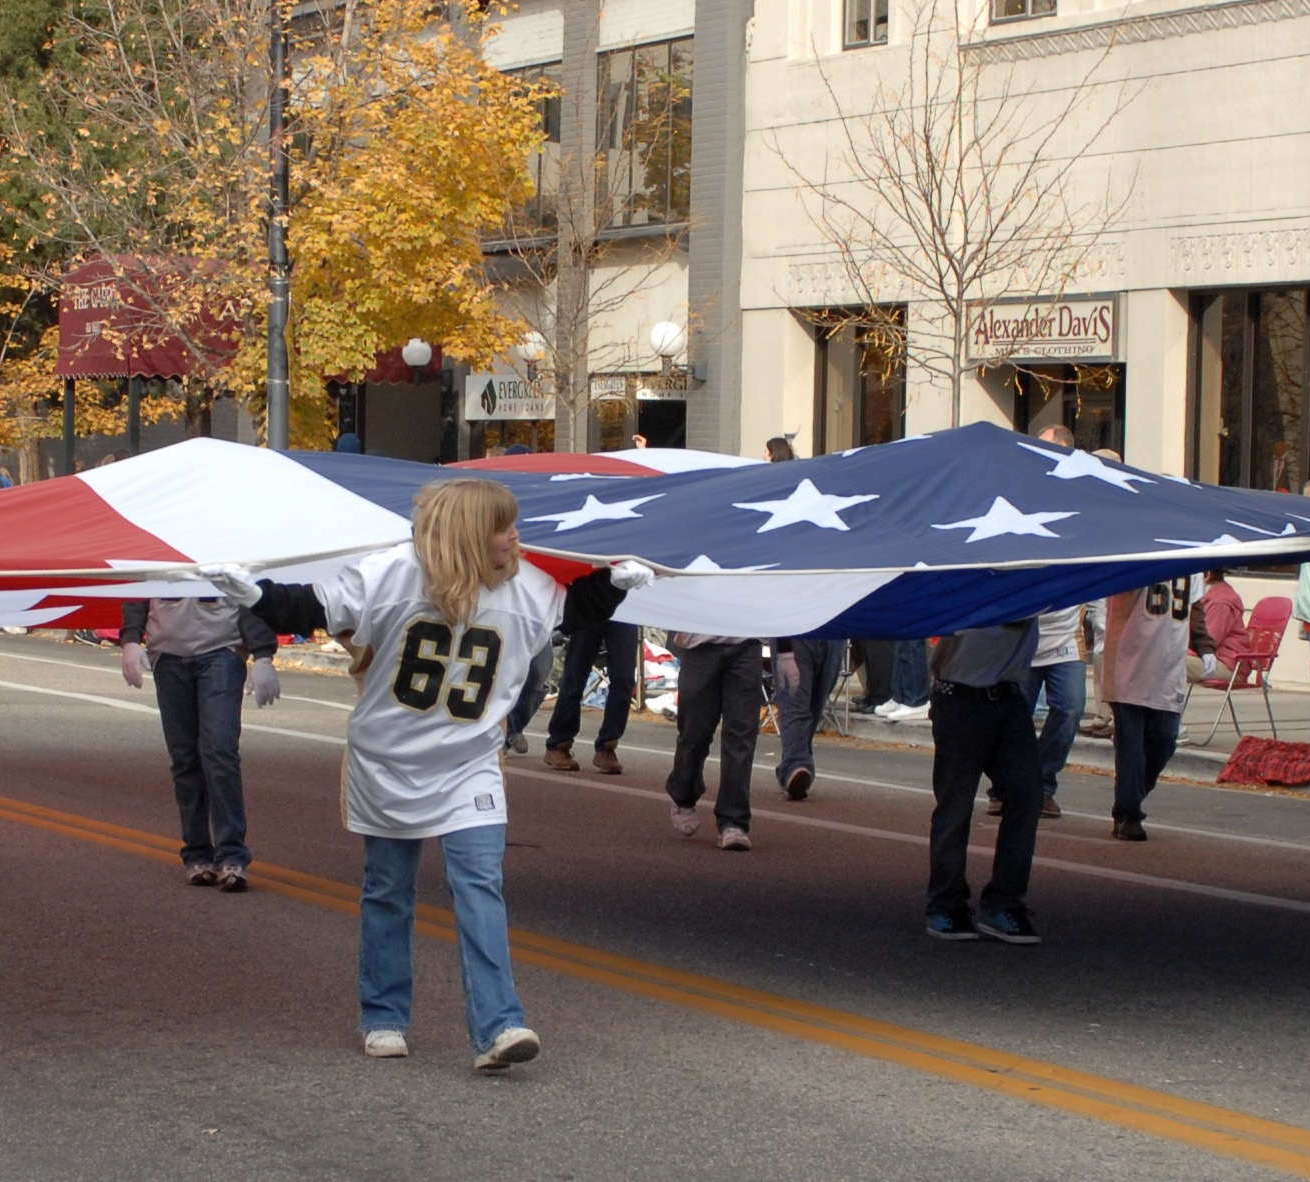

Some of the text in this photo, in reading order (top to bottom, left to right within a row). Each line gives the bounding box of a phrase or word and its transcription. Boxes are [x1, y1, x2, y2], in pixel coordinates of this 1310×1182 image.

[974, 308, 1056, 345] Alexander
[1033, 345, 1095, 355] CLOTHING
[392, 616, 504, 723] 63
